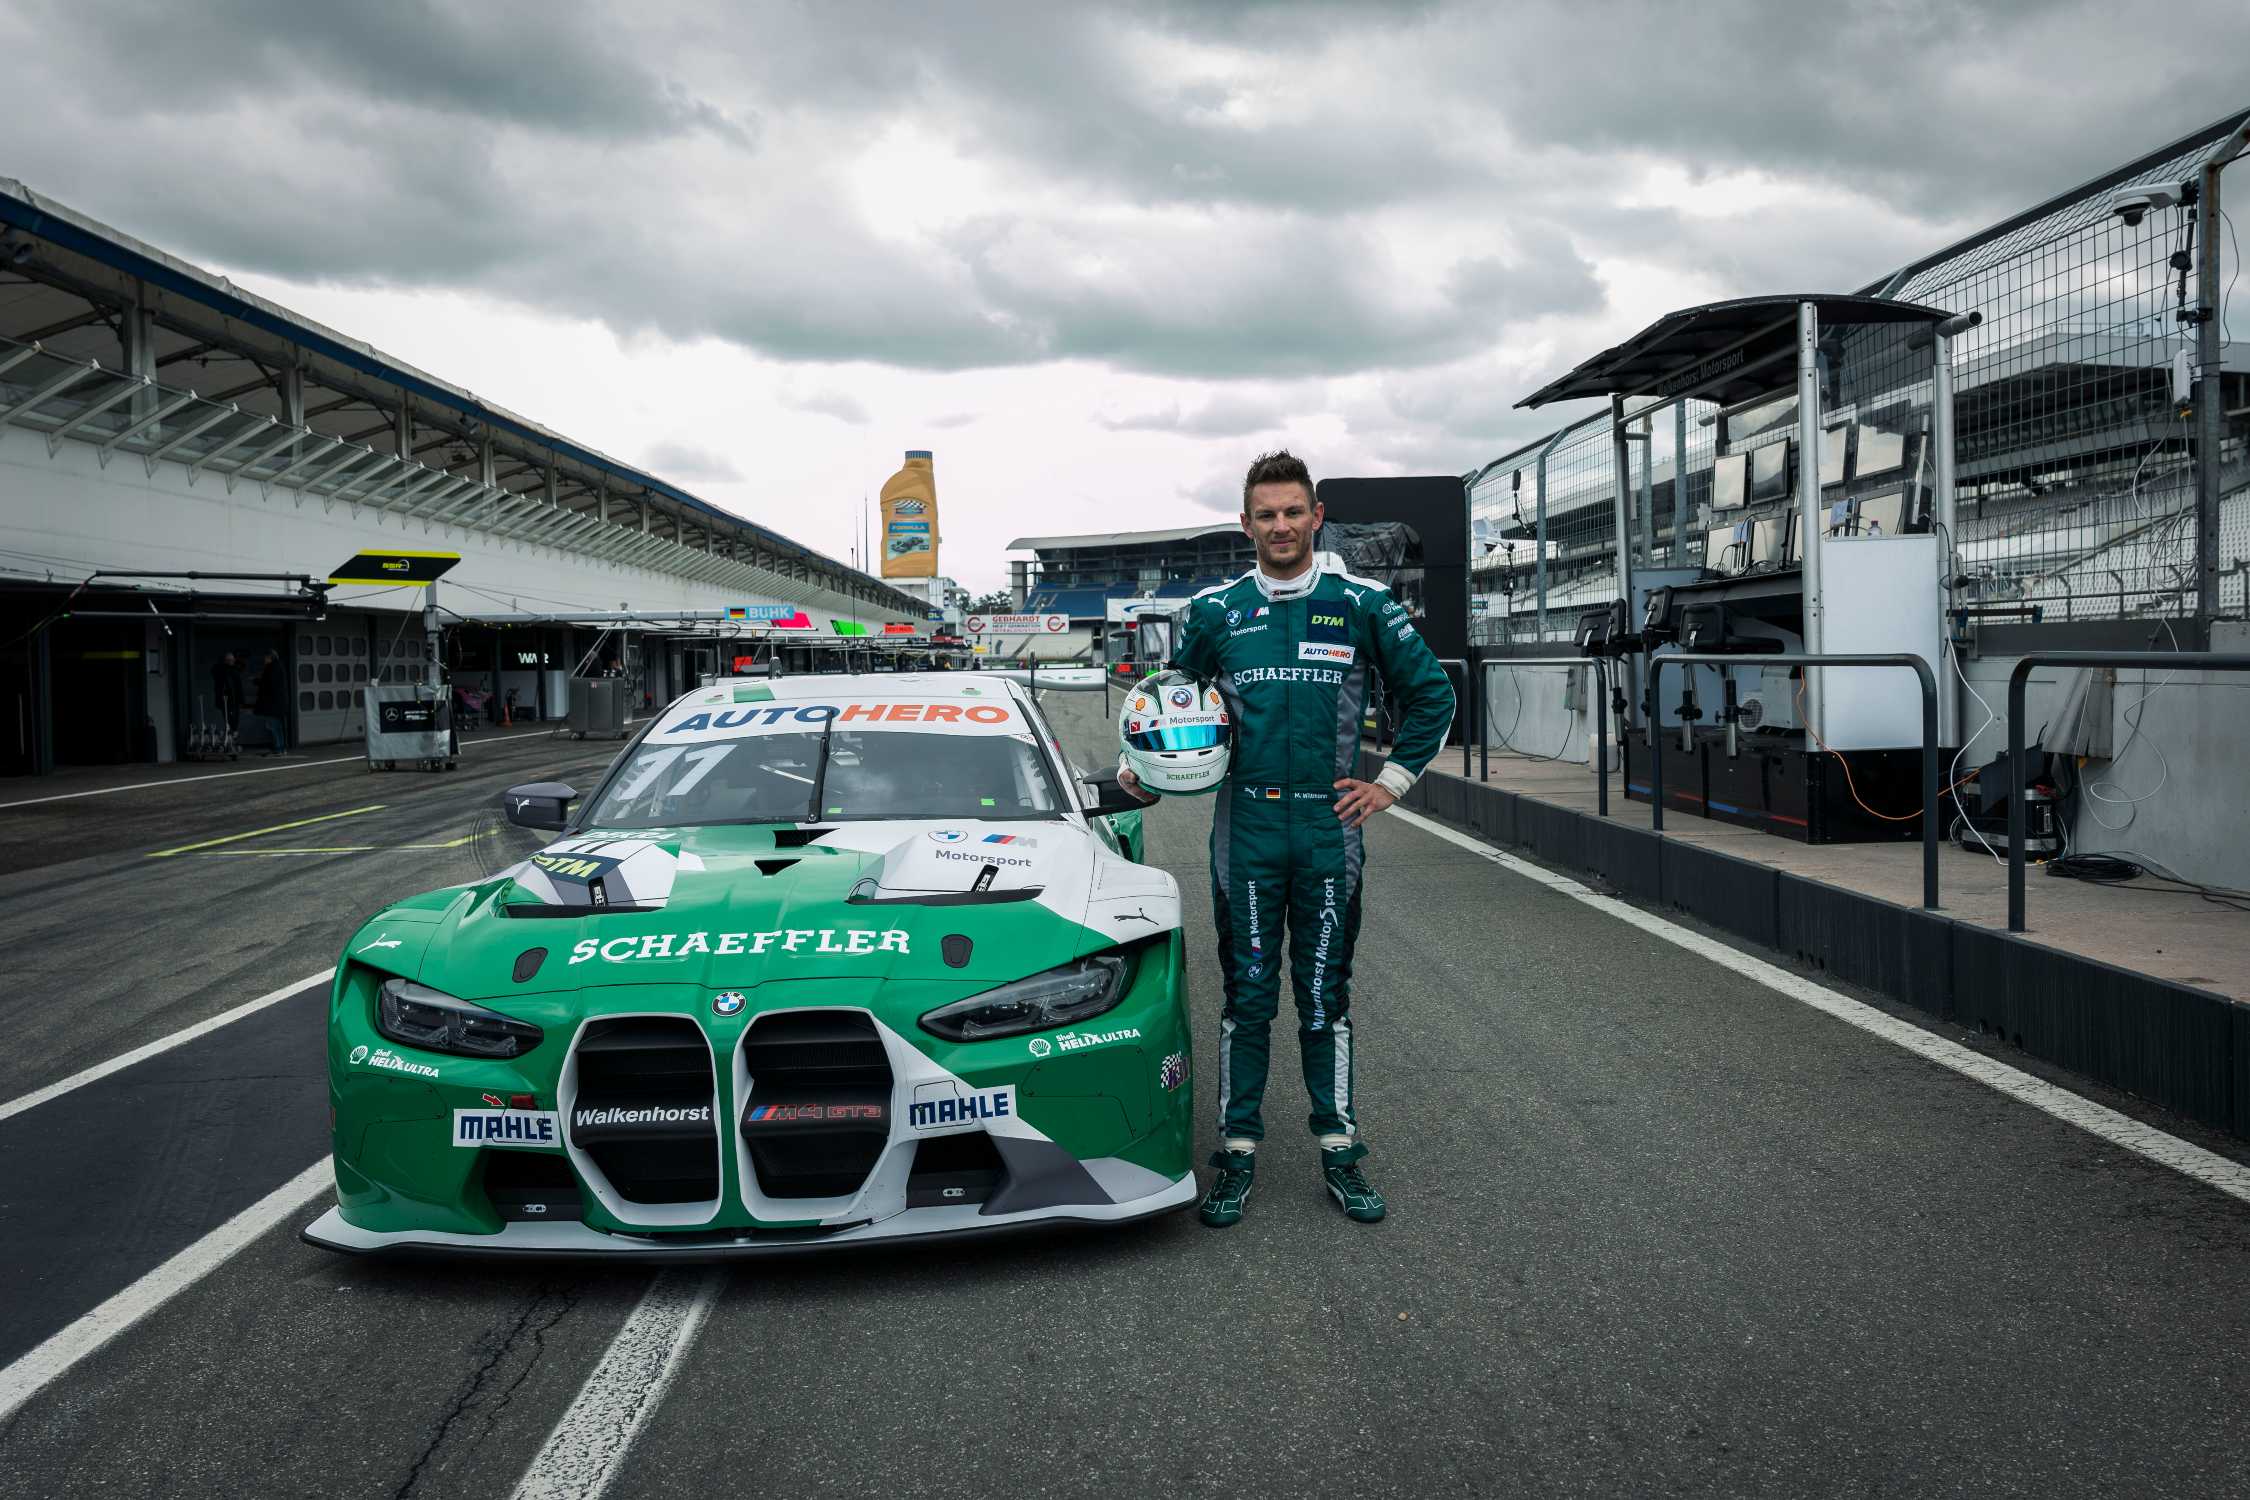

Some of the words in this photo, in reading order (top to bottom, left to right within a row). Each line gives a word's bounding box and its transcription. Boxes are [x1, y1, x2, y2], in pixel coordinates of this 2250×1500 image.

[1700, 347, 1744, 380] Motorsport
[750, 607, 791, 619] BUHK
[992, 615, 1040, 623] GEBHARDT
[1311, 615, 1345, 627] DTM
[1230, 623, 1268, 638] Motorsport
[1304, 647, 1351, 659] AUTOHERO
[1233, 667, 1344, 686] SCHAEFFLER
[664, 704, 1010, 735] AUTOHERO
[1169, 714, 1215, 728] Motorsport
[618, 744, 735, 801] 11
[1166, 770, 1210, 781] SCHAEFFLER
[528, 854, 602, 878] DTM
[935, 849, 1032, 867] Motorsport
[1248, 880, 1259, 935] Motorsport
[568, 929, 911, 965] SCHAEFFLER
[1311, 962, 1326, 1031] Wlkenhorst
[1056, 1032, 1076, 1042] Shell
[1059, 1033, 1104, 1051] HELIX
[1102, 1028, 1141, 1042] ULTRA
[374, 1049, 392, 1057] Shell
[368, 1055, 404, 1070] HELIX
[404, 1062, 439, 1078] ULTRA
[577, 1105, 709, 1127] Walkenhorst
[828, 1105, 881, 1118] GT3
[909, 1093, 1009, 1126] MAHLE
[460, 1116, 553, 1140] MAHLE
